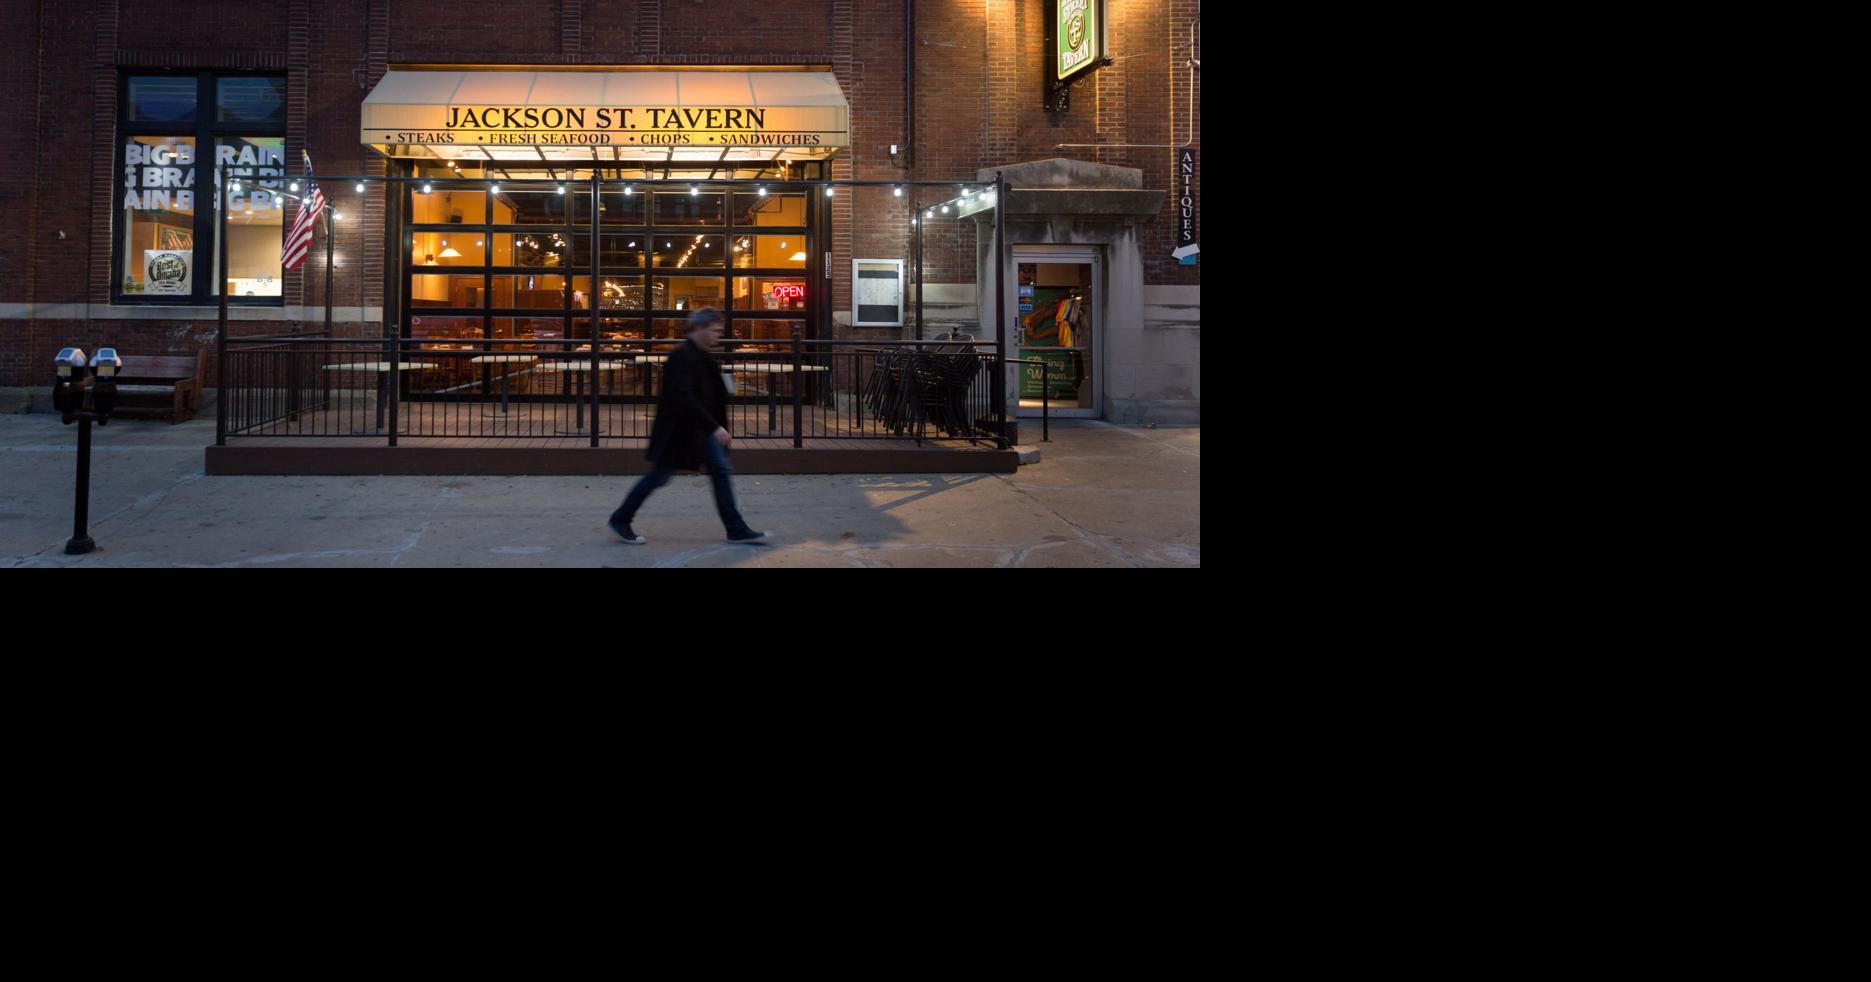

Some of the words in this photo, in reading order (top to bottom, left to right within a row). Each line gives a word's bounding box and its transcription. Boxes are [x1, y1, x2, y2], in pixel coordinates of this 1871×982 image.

[446, 107, 586, 129] JACKSON
[596, 108, 636, 129] ST.
[646, 108, 766, 129] TAVERN
[397, 132, 455, 144] STEAKS
[489, 133, 537, 144] FRESH
[541, 133, 610, 145] SEAFOOD
[640, 133, 691, 145] CHOPS
[719, 134, 820, 146] SANDWICHES
[125, 144, 170, 166] BIG
[1181, 151, 1193, 241] ANTIQUES
[774, 285, 804, 298] OPEN
